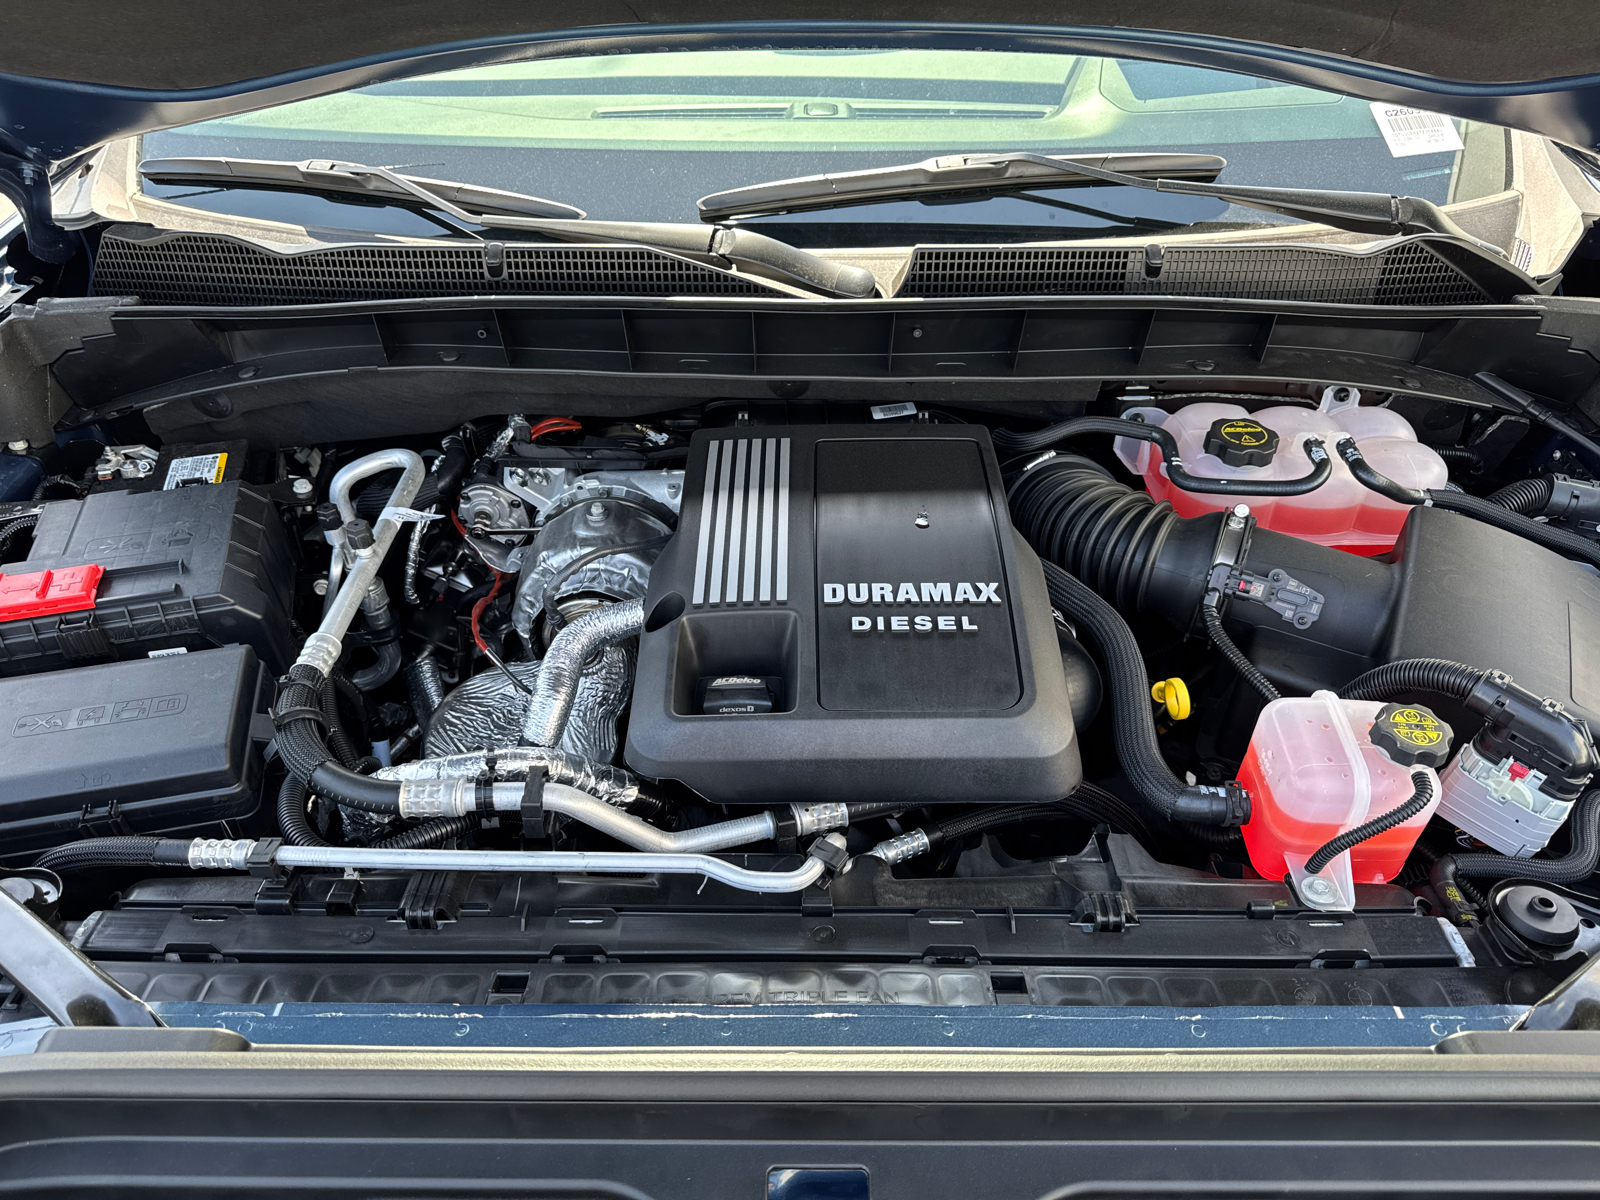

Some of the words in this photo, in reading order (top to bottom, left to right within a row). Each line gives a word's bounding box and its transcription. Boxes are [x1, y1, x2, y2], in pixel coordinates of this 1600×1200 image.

[823, 582, 1002, 604] DURAMAX
[851, 615, 979, 633] DIESEL
[711, 677, 762, 687] ACDelco
[769, 990, 848, 1004] TRIPLE
[855, 990, 900, 1004] FAN
